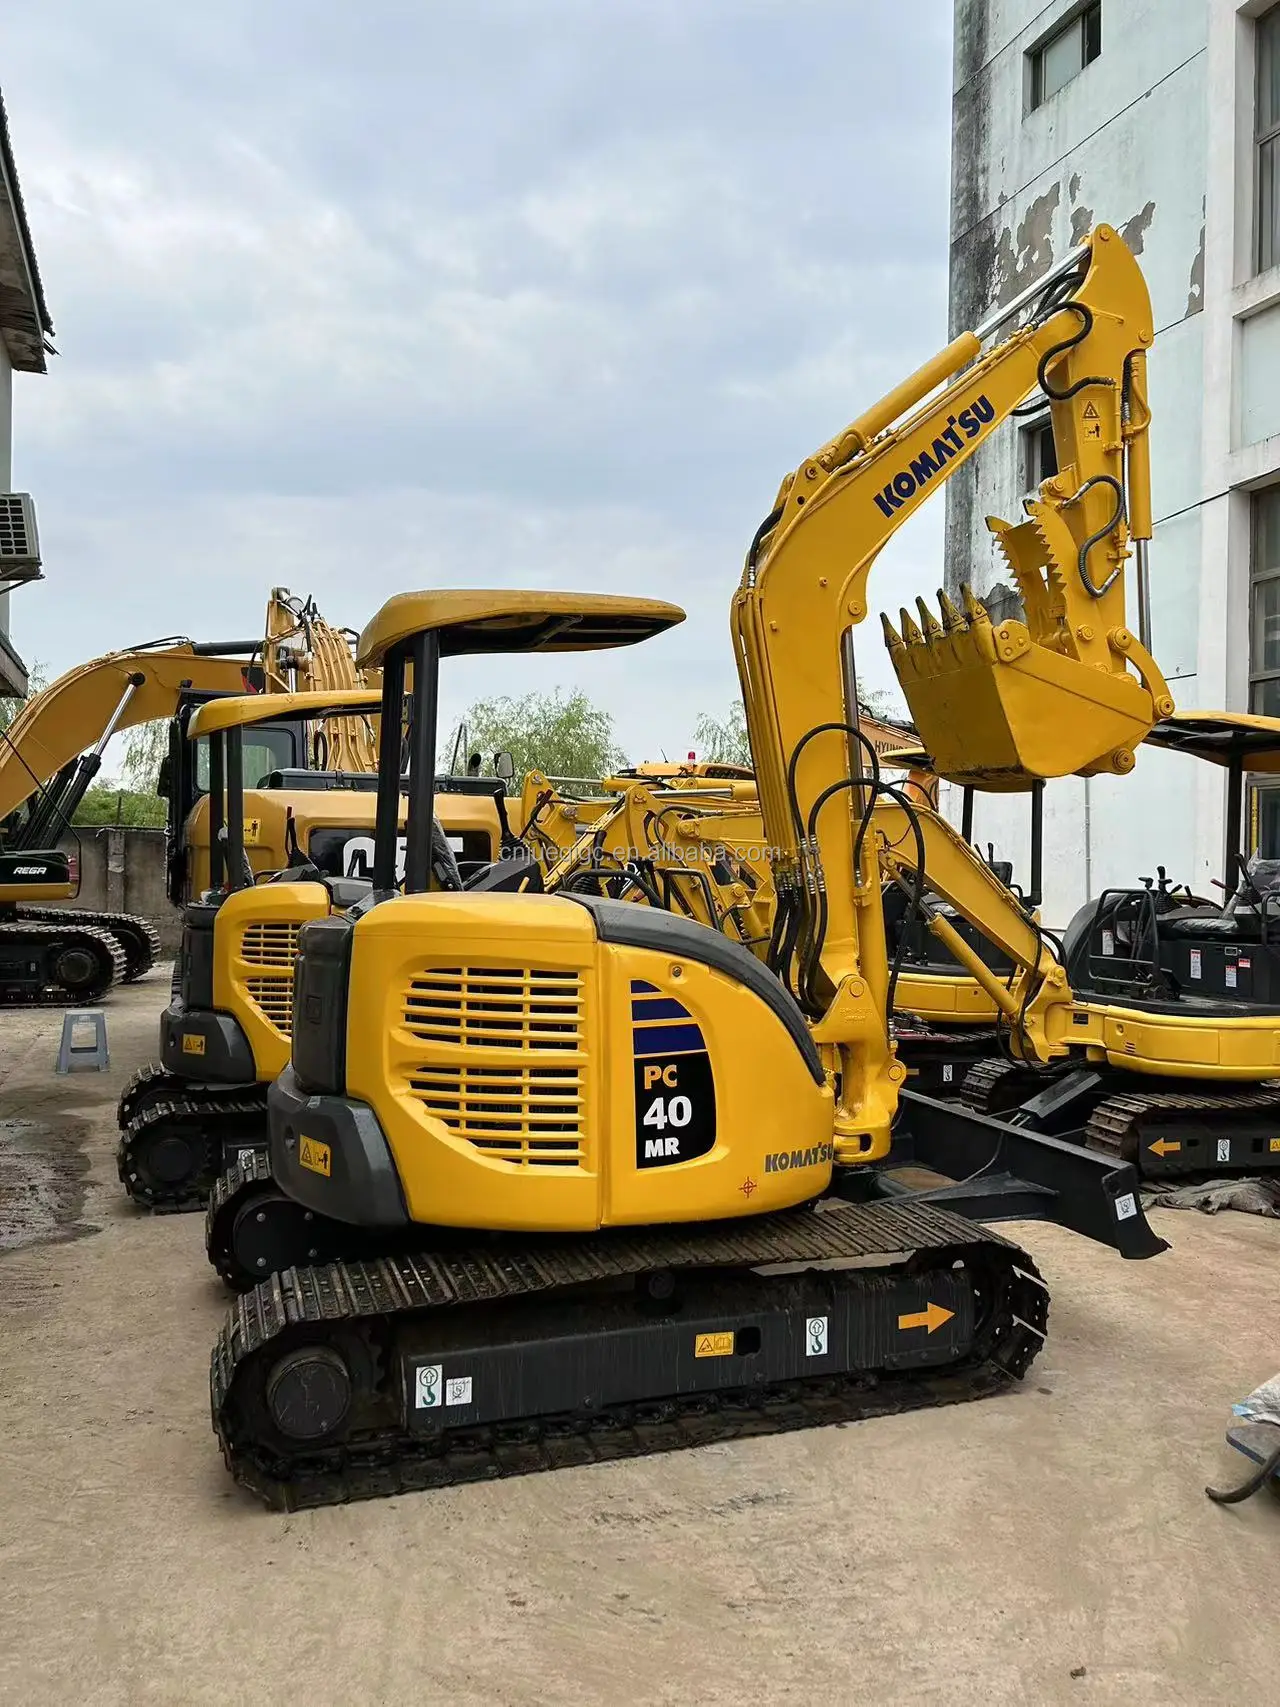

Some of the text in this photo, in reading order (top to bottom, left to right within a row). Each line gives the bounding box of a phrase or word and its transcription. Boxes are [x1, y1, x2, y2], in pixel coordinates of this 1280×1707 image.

[873, 394, 995, 518] KOMATSU
[644, 1065, 677, 1089] PC
[643, 1096, 692, 1129] 40
[645, 1137, 680, 1158] MR
